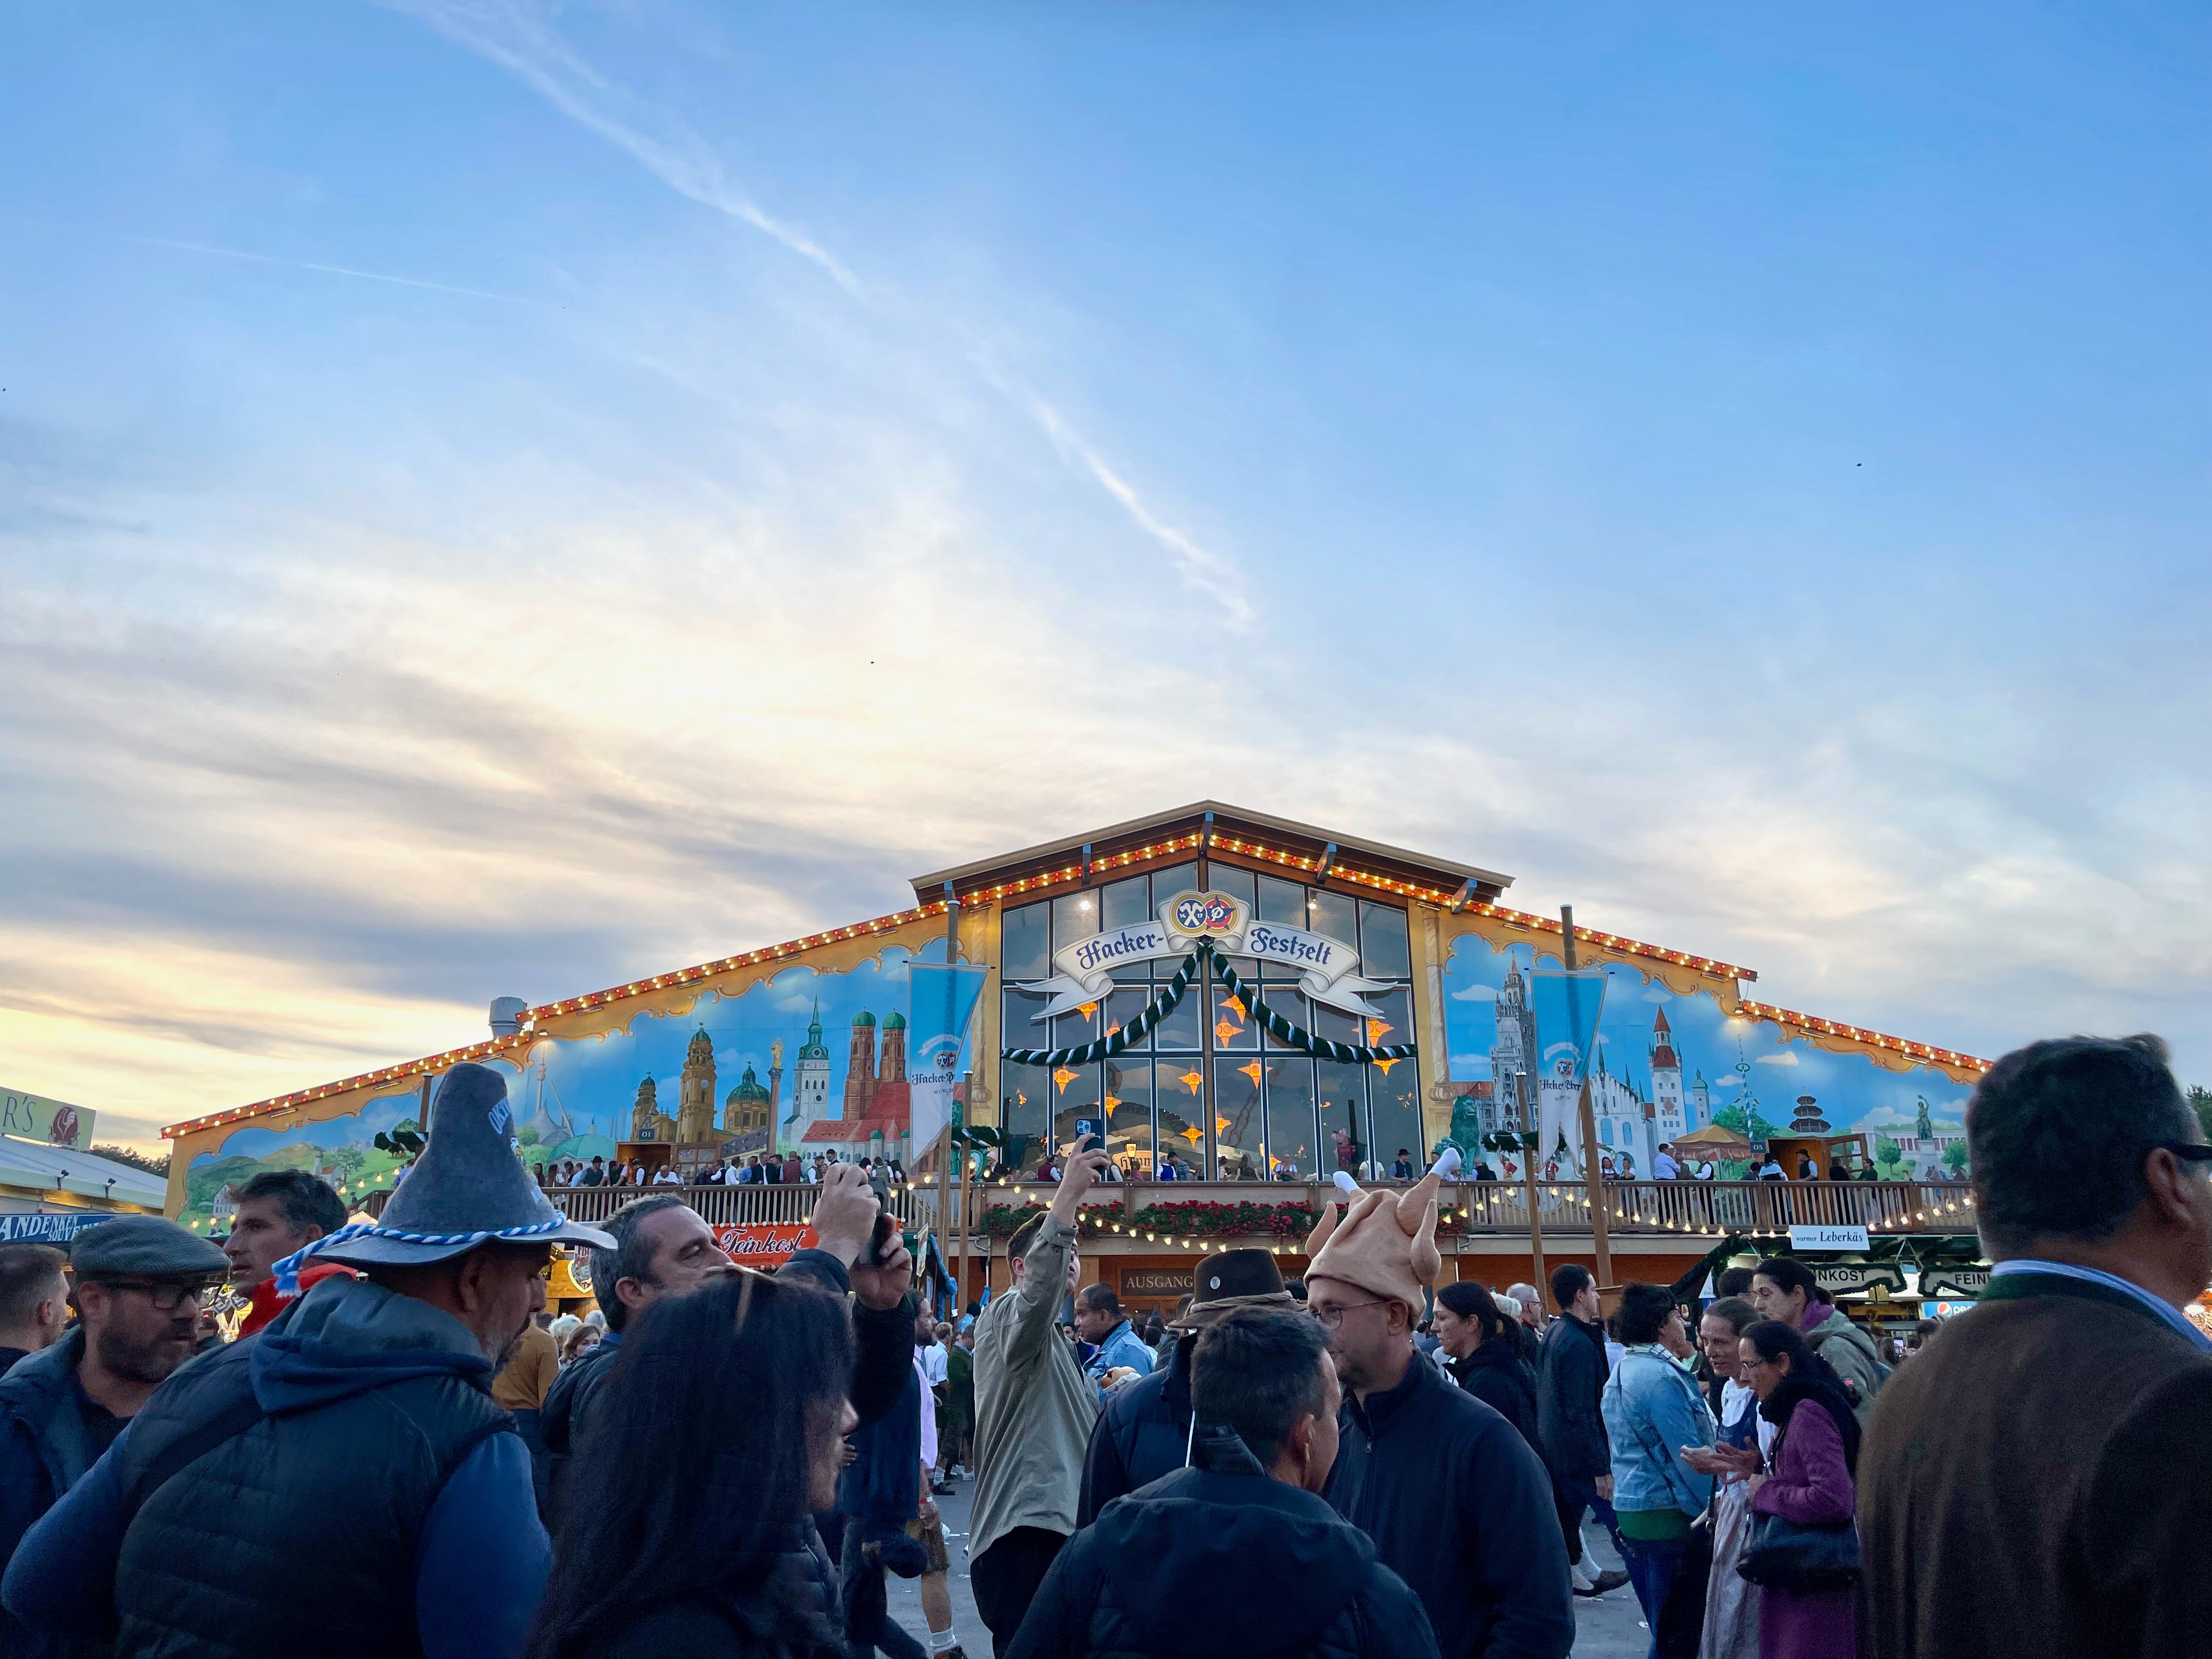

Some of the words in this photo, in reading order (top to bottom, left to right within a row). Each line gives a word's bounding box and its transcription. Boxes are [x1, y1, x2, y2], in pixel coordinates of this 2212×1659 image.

[1076, 932, 1164, 969] Hacker-
[1250, 927, 1331, 965] Festzelt
[720, 1228, 806, 1254] Feinkost
[1820, 1232, 1863, 1242] Leberkäs
[1127, 1276, 1193, 1288] AUSGANG
[1814, 1270, 1866, 1282] NKOST
